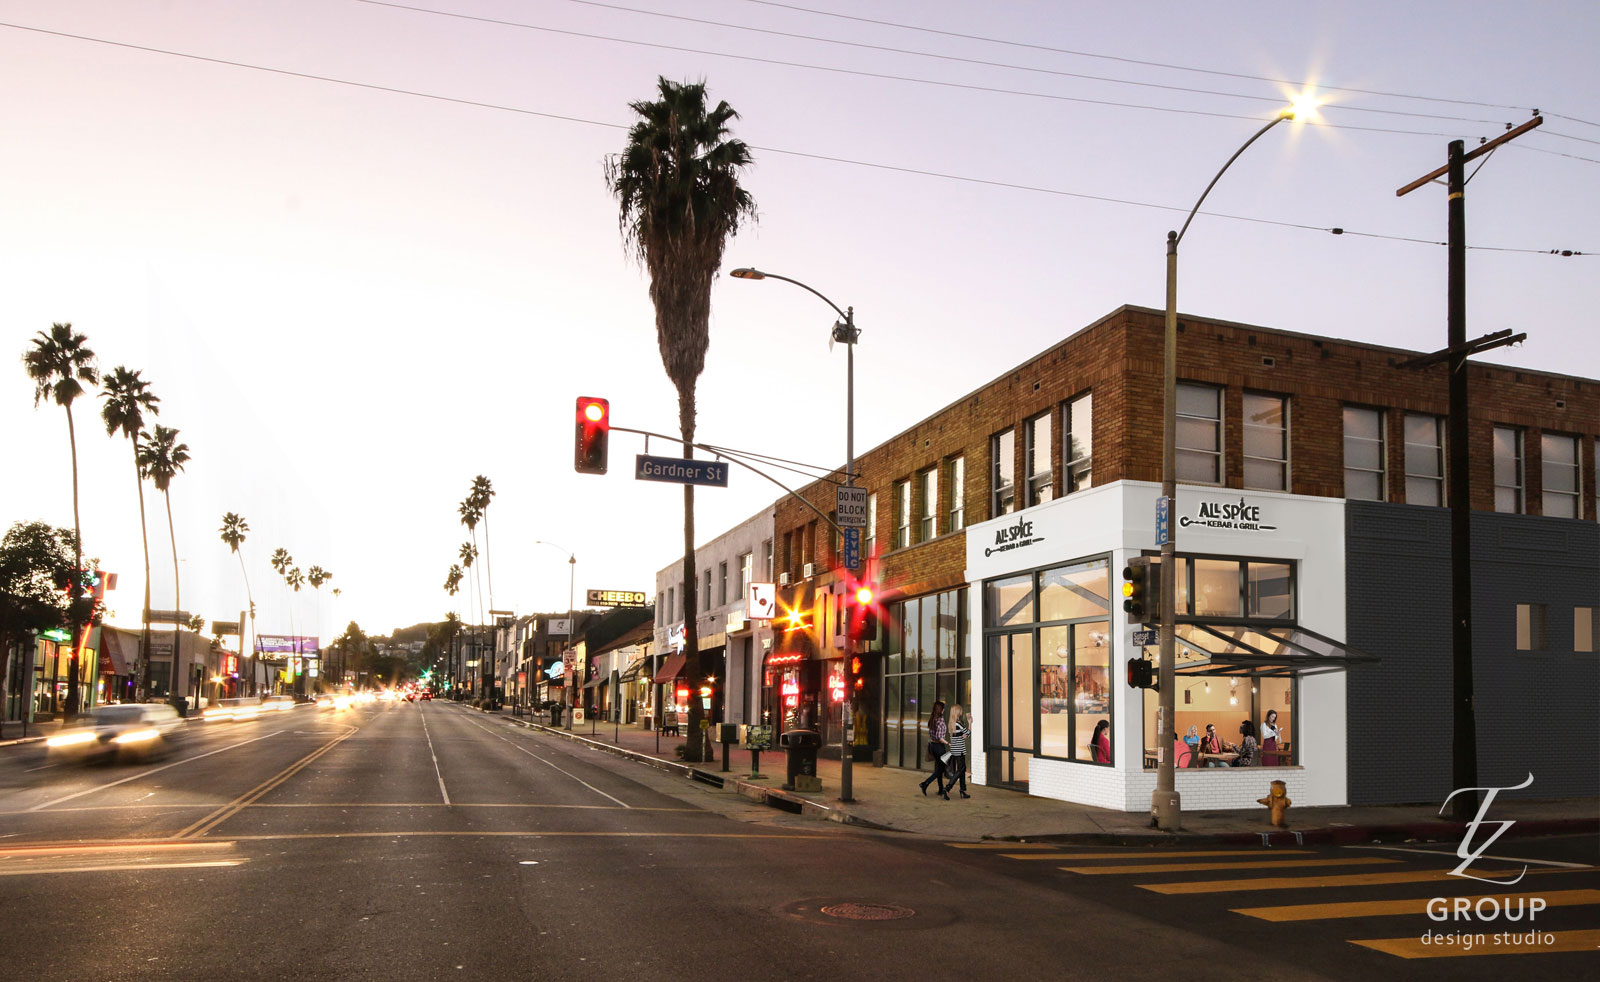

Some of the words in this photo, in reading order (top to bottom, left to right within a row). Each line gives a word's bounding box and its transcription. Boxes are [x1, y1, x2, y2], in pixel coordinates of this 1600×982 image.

[643, 461, 701, 478] Gardner
[706, 467, 721, 480] St
[839, 491, 849, 501] DO
[851, 493, 865, 502] NOT
[838, 504, 865, 515] BLOCK
[1199, 502, 1221, 518] ALL
[1207, 520, 1232, 528] KEBAB
[1239, 523, 1260, 531] GRILL
[995, 528, 1009, 545] ALL
[850, 531, 858, 567] SYNC
[588, 590, 645, 603] CHEEBO
